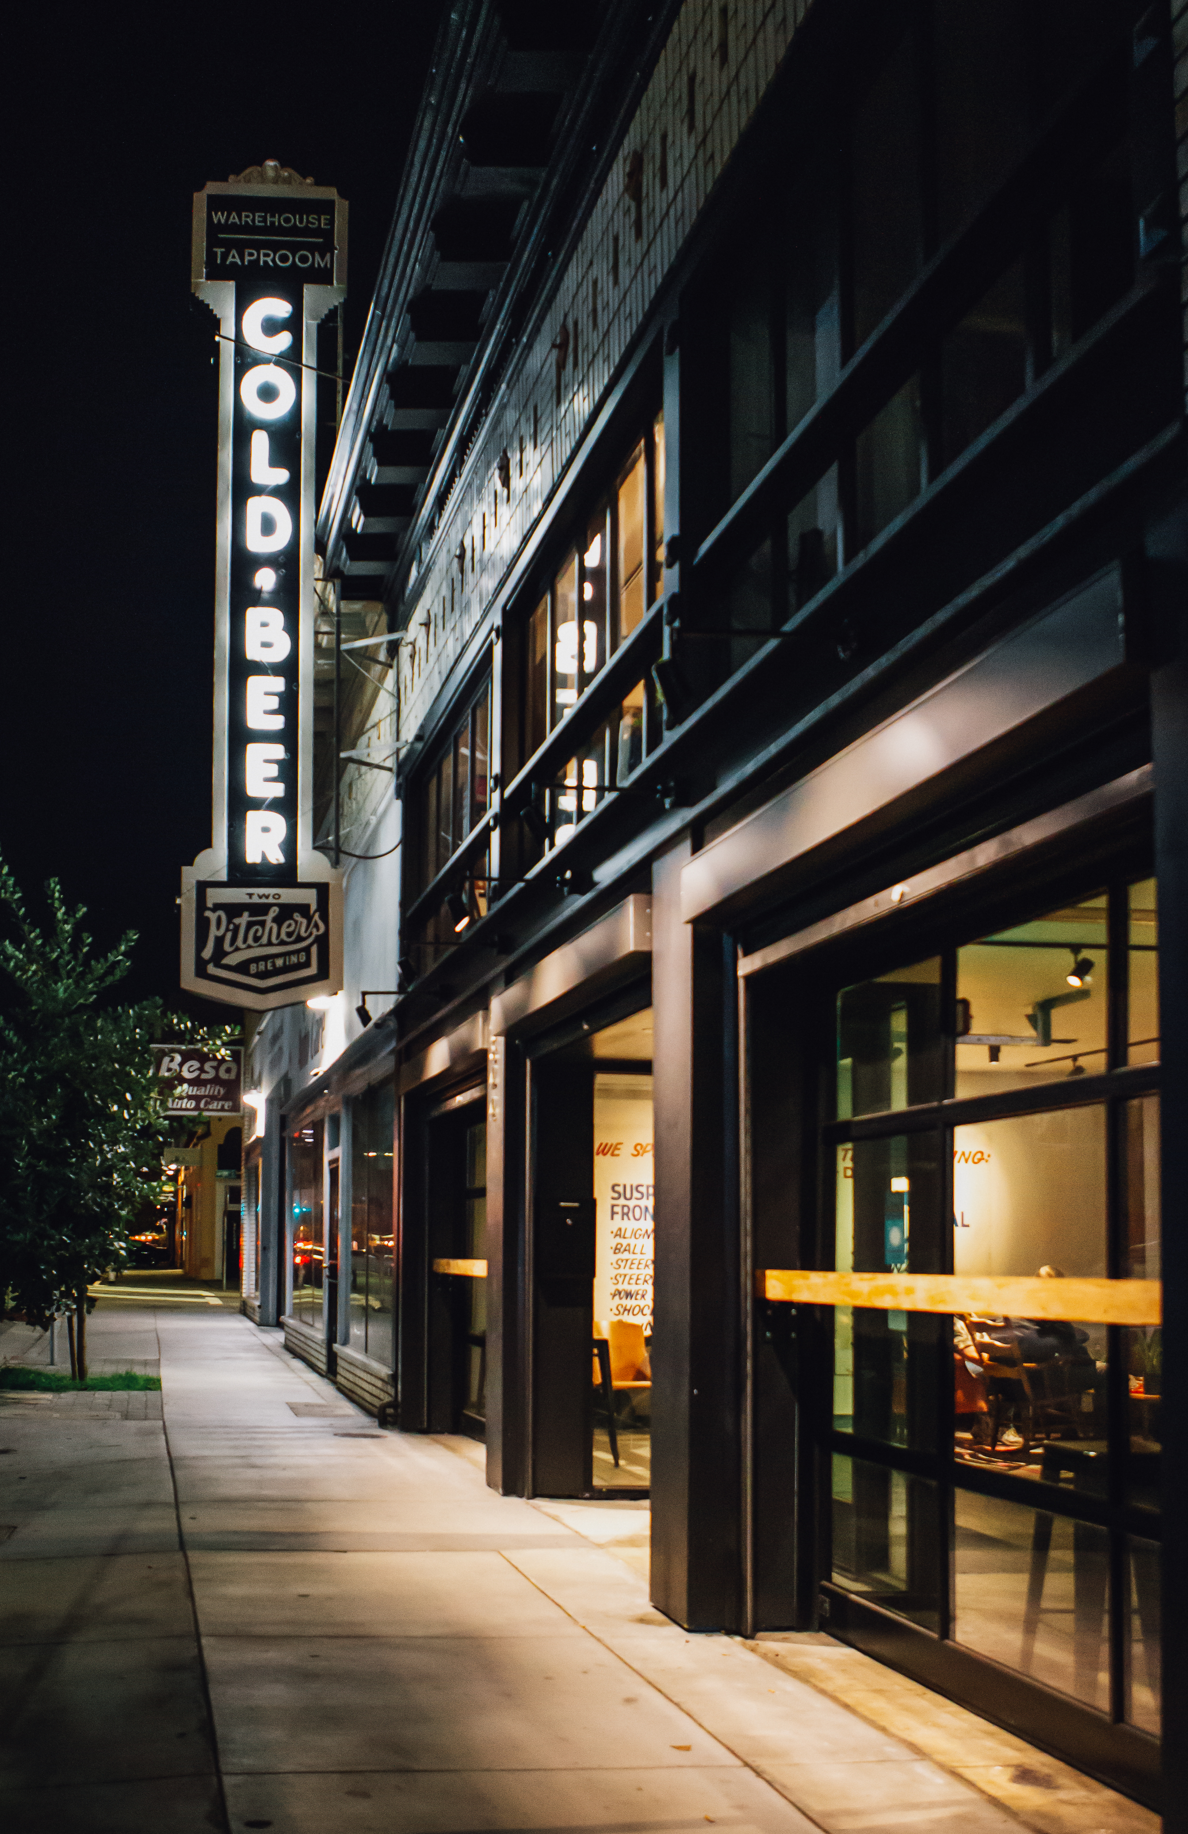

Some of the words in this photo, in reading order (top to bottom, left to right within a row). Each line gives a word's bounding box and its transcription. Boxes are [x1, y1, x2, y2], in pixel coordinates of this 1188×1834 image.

[211, 211, 331, 229] WAREHOUSE
[213, 248, 331, 269] TAPROOM
[239, 297, 296, 553] COLD
[245, 606, 292, 865] BEER
[201, 906, 326, 960] Pitchers
[250, 952, 306, 974] BREWING
[200, 1098, 233, 1109] Care
[595, 1142, 624, 1157] WE
[630, 1142, 655, 1158] SP
[610, 1183, 655, 1201] SUSP
[613, 1303, 654, 1317] SHOC
